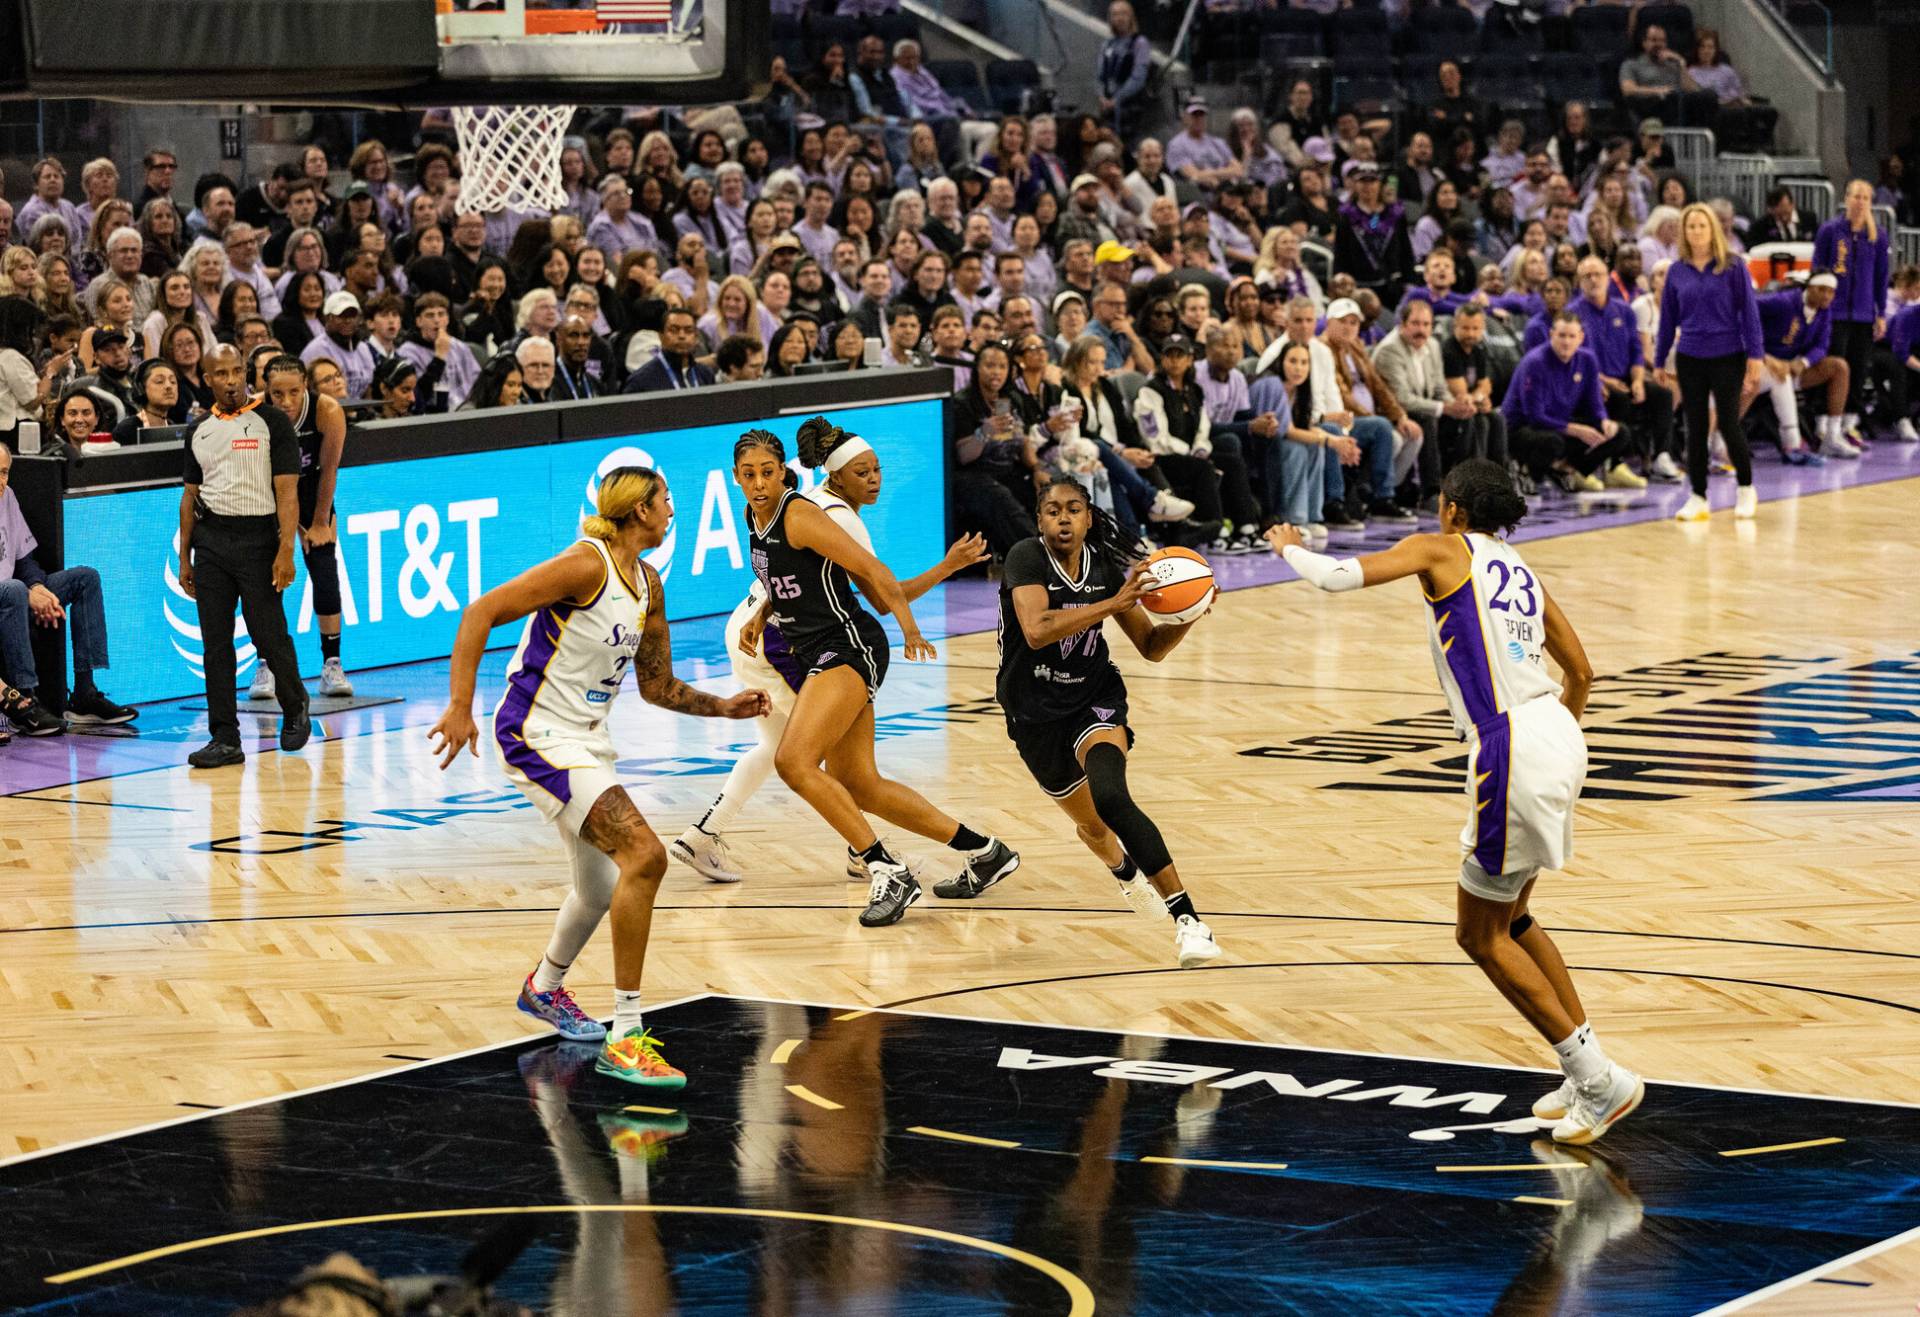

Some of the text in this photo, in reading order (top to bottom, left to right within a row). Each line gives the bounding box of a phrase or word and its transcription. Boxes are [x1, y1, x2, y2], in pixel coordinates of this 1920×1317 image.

[225, 121, 238, 137] 12
[225, 142, 238, 156] 11
[770, 574, 802, 599] 25
[1487, 559, 1537, 617] 23
[997, 1046, 1508, 1115] WNBA
